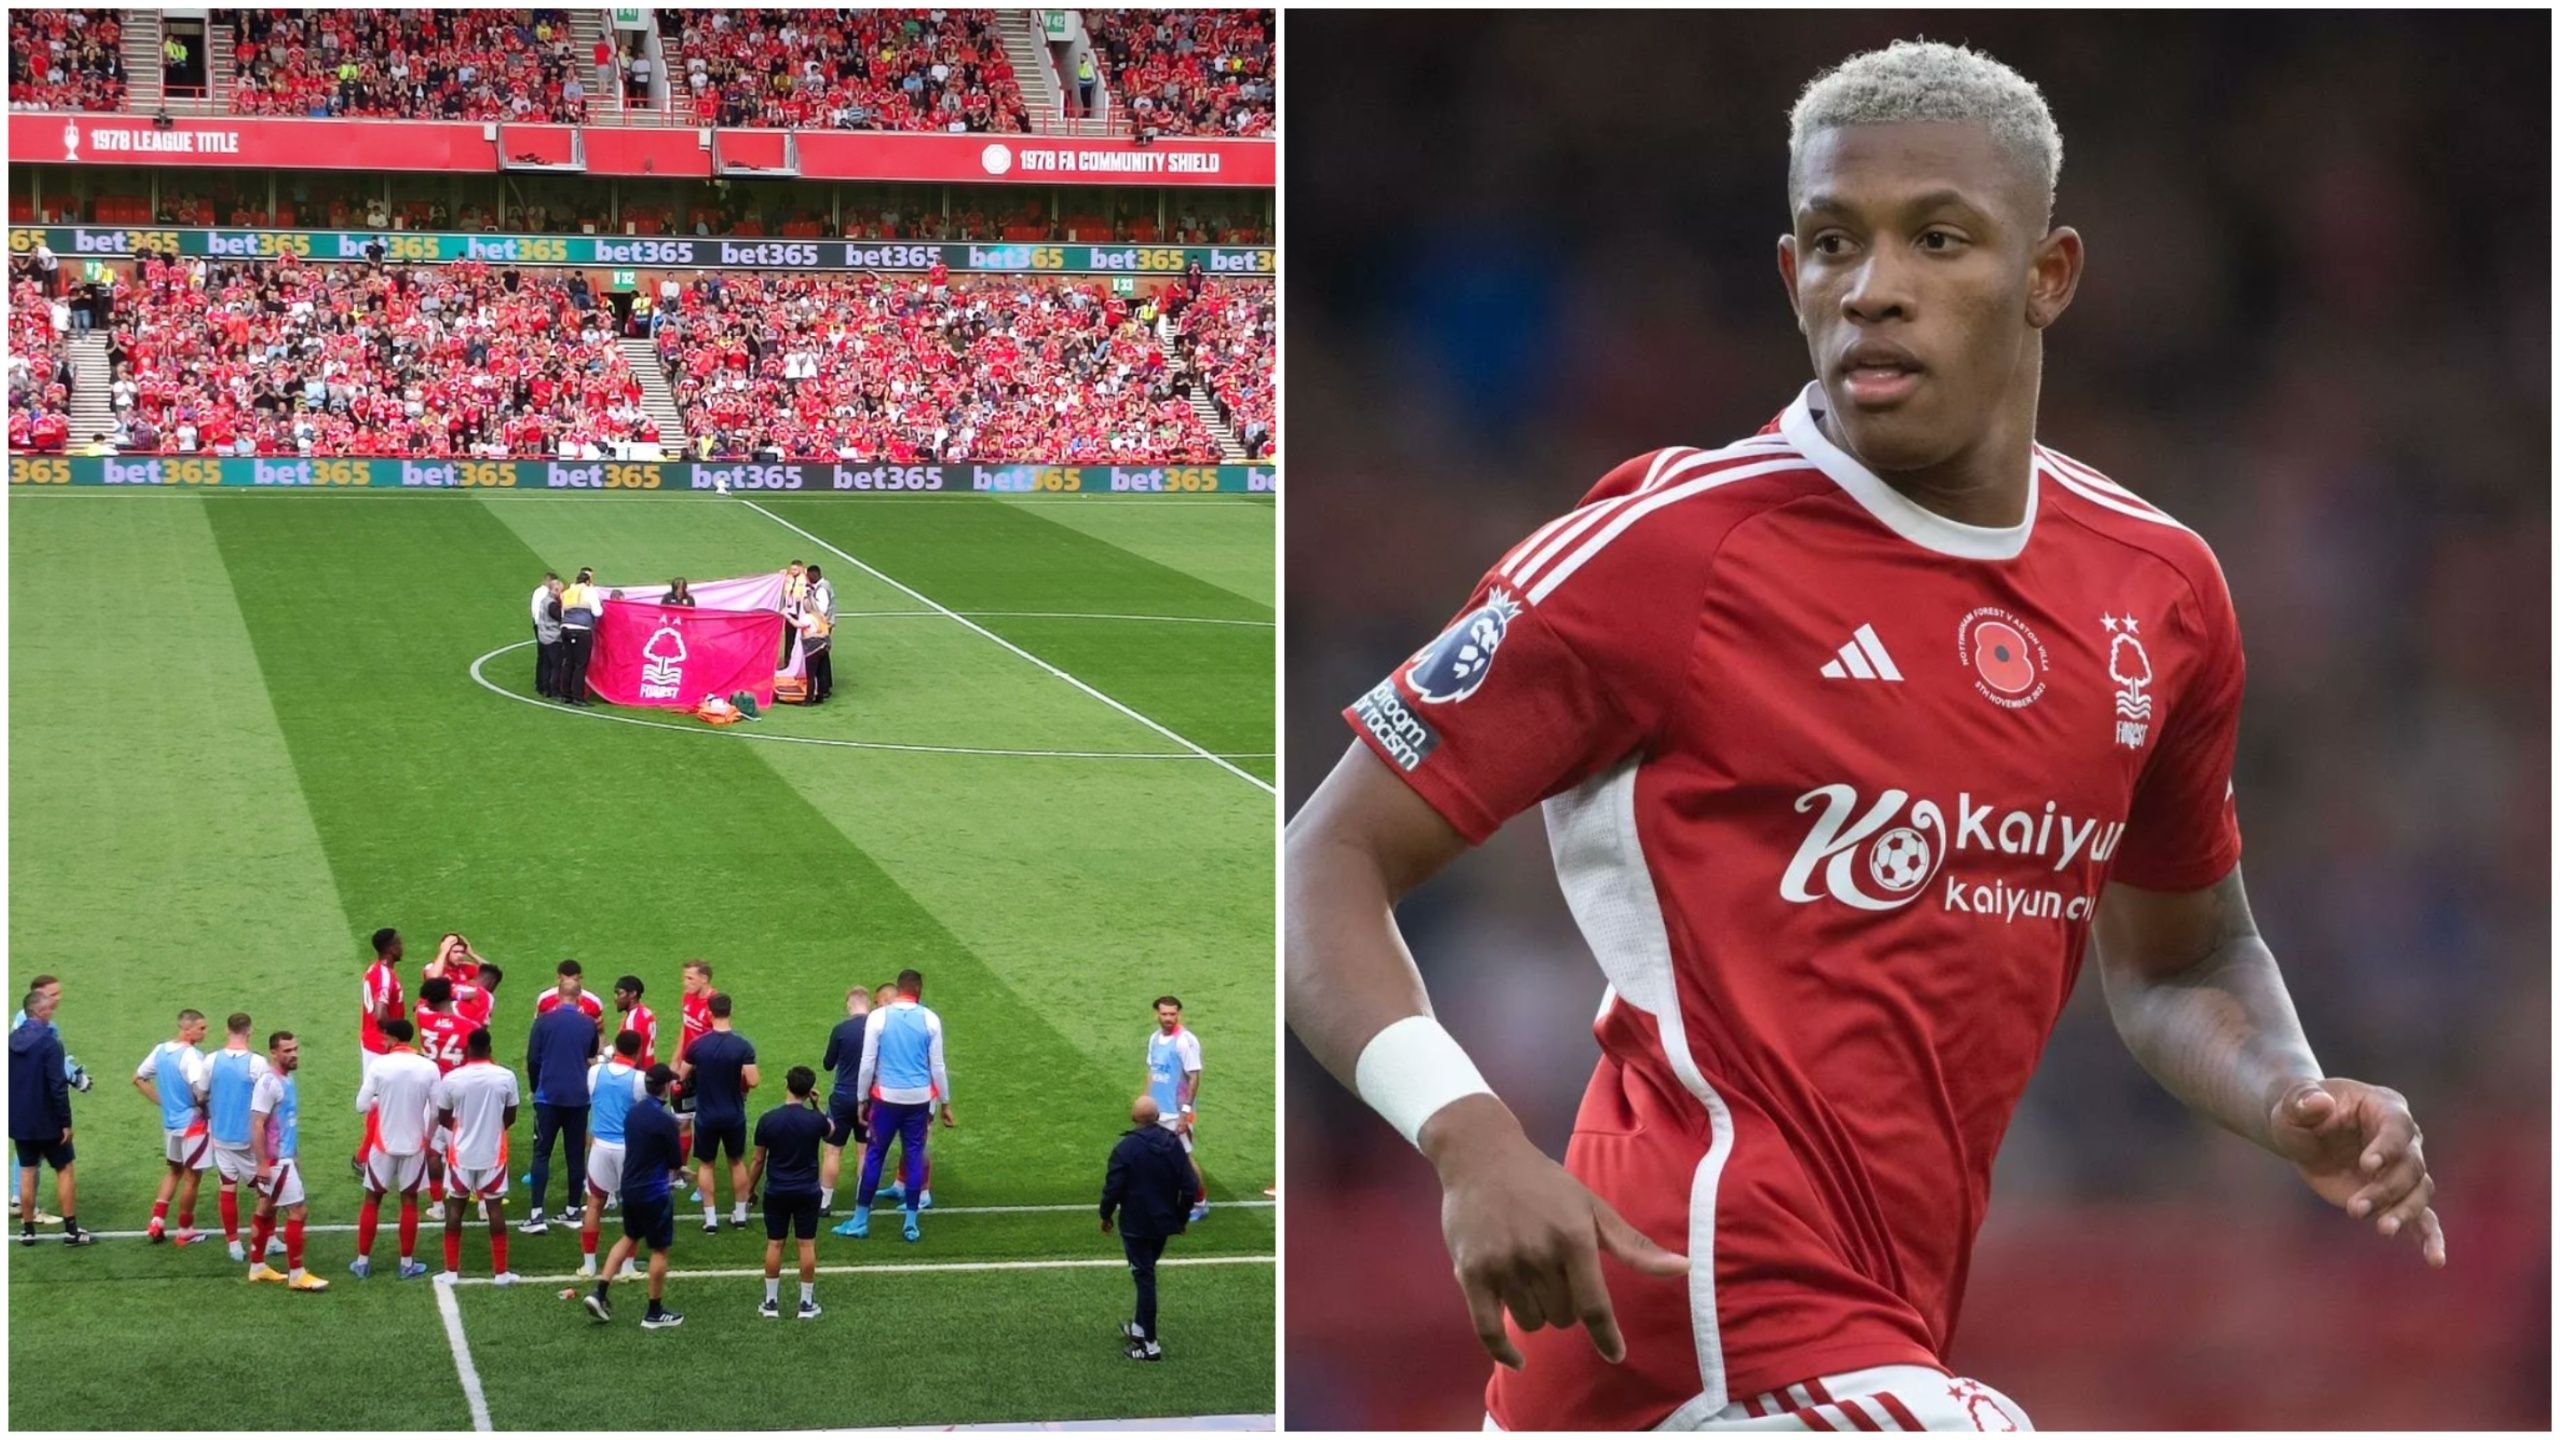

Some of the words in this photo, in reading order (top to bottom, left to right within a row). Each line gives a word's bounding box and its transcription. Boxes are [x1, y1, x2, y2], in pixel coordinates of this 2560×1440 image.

[91, 130, 131, 150] 1978
[133, 131, 194, 151] LEAGUE
[196, 132, 239, 153] TITLE
[1020, 151, 1055, 171] 1978
[1058, 151, 1076, 171] FA
[1078, 151, 1165, 172] COMMUNITY
[1168, 153, 1220, 173] SHIELD
[75, 229, 179, 253] bet365
[208, 232, 310, 256] bet365
[467, 237, 567, 261] bet365
[595, 239, 693, 263] bet365
[721, 242, 818, 266] bet365
[845, 244, 942, 267] bet365
[969, 246, 1064, 269] bet365
[1090, 248, 1184, 271] bet365
[1210, 249, 1276, 272] bet3
[104, 457, 222, 484] bet365
[254, 458, 371, 486] bet365
[402, 460, 517, 486] bet365
[547, 462, 661, 488] bet365
[691, 463, 802, 489] bet365
[833, 466, 943, 491] bet365
[973, 465, 1081, 491] bet365
[1111, 466, 1218, 492] bet365
[421, 1028, 464, 1065] 34
